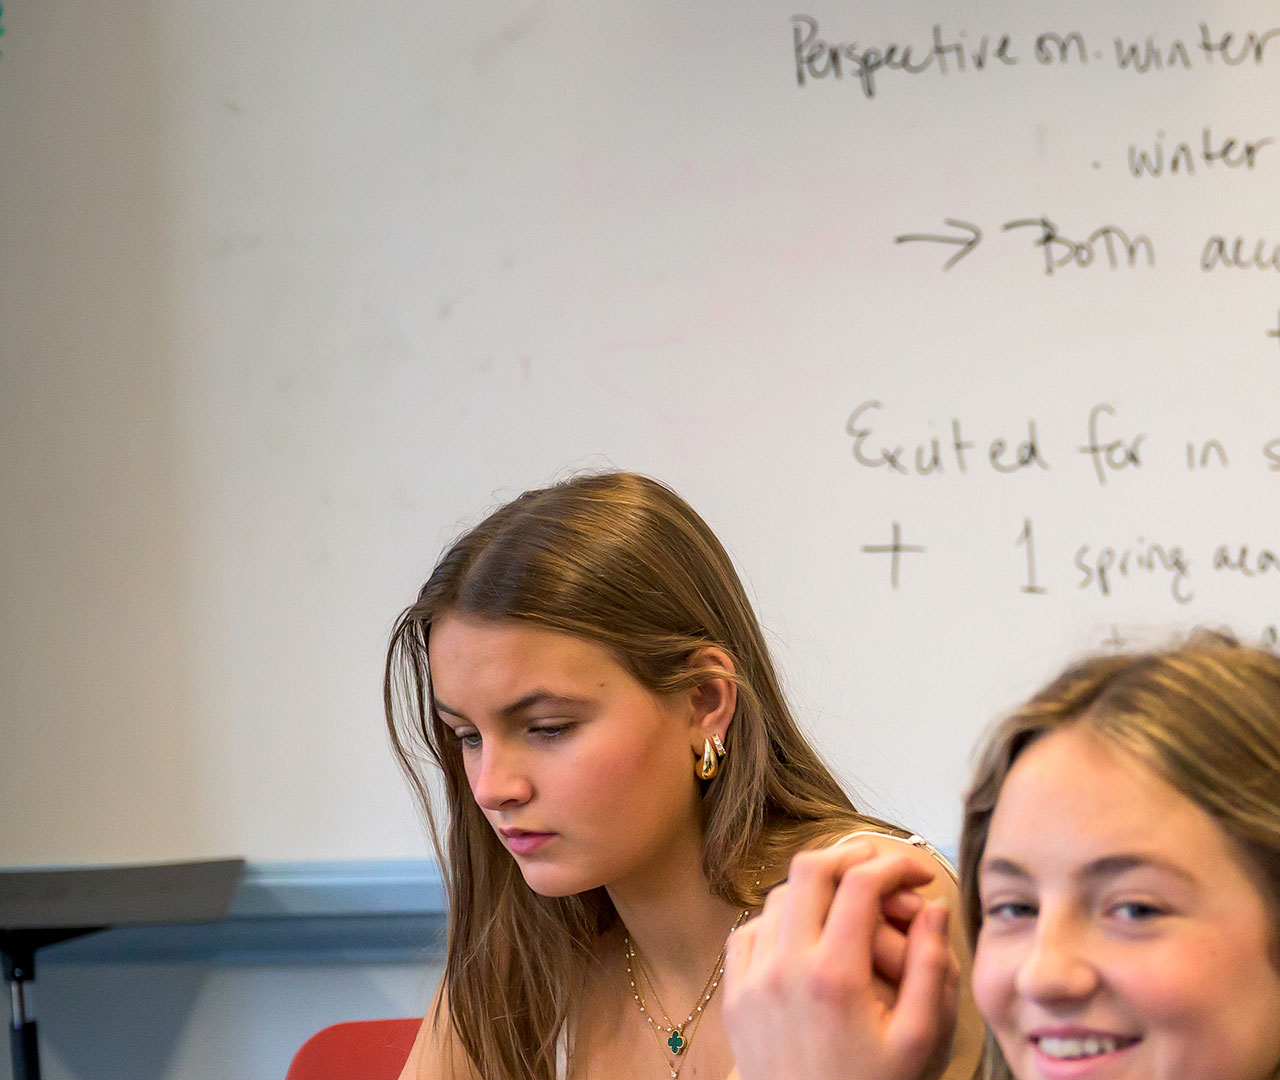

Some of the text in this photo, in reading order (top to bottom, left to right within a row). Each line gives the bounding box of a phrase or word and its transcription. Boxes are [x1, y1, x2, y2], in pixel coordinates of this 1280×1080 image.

[790, 14, 1018, 101] Perspective
[1127, 127, 1276, 179] winter
[1000, 215, 1156, 278] Both
[1078, 403, 1146, 486] for
[1185, 430, 1229, 471] in
[1015, 517, 1048, 596] 1
[1074, 536, 1195, 605] spring
